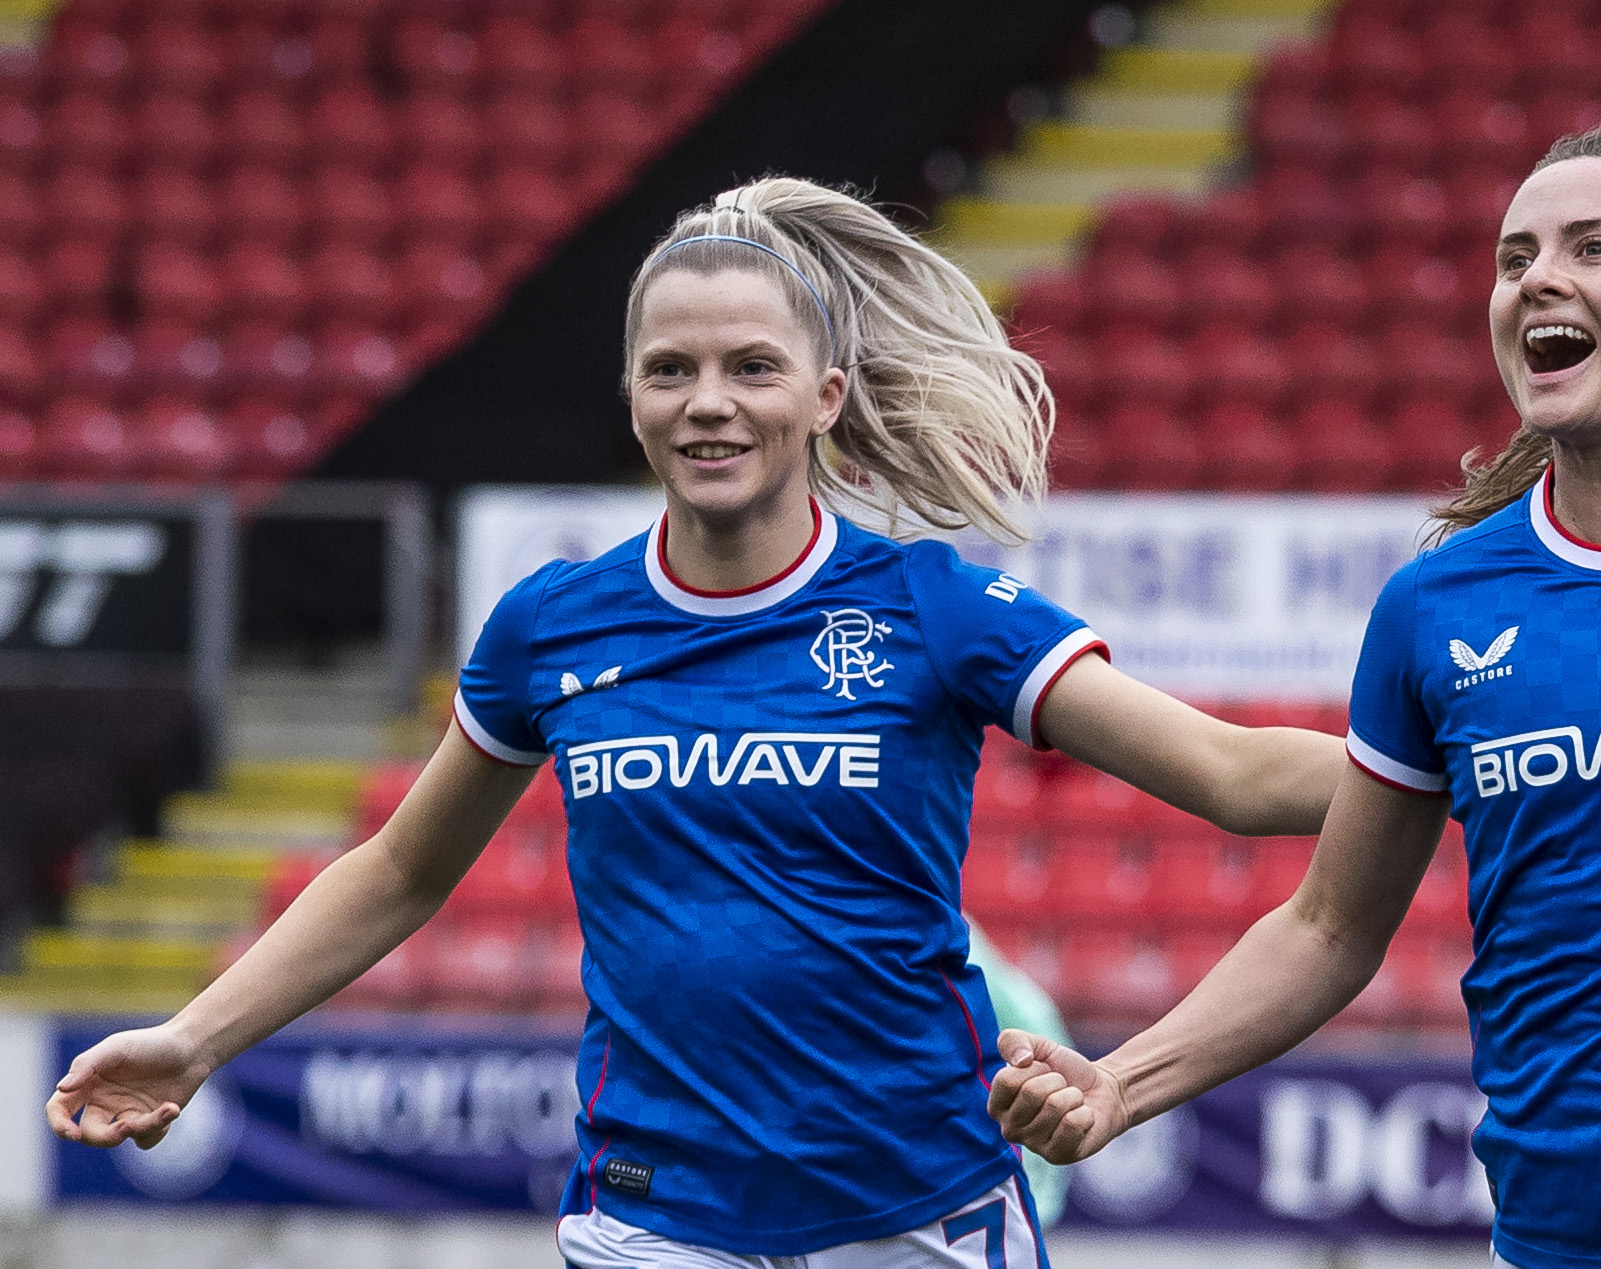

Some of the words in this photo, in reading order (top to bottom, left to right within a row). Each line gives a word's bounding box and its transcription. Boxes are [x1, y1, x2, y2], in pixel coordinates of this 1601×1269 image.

[1455, 664, 1513, 691] CASTORE
[567, 732, 881, 800] BIOWAVE
[1257, 1073, 1494, 1227] DC
